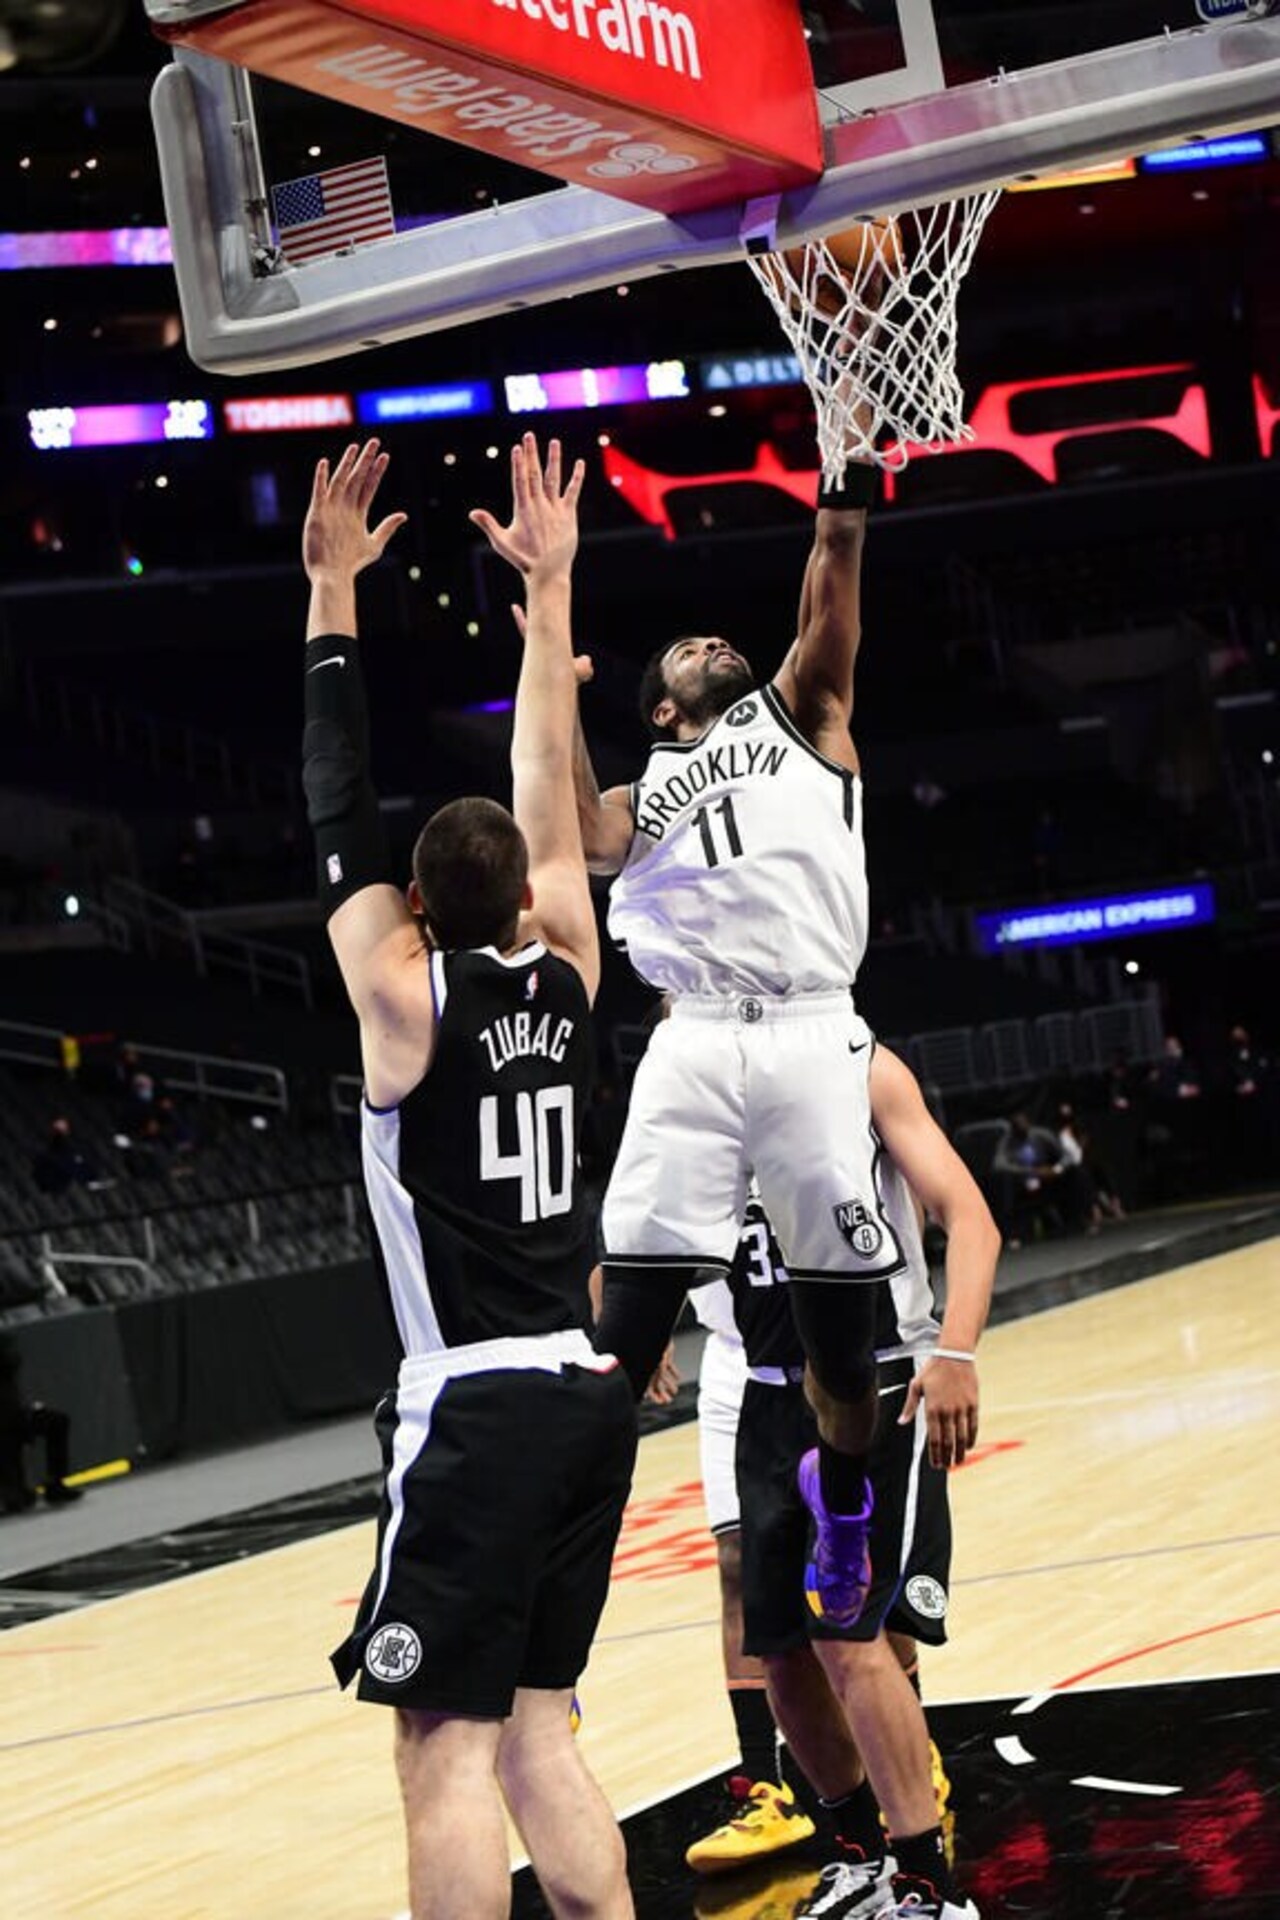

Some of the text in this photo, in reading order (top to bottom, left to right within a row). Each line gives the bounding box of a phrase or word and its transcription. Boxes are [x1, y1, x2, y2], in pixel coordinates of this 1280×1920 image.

[224, 396, 352, 431] TOSHIBA
[636, 742, 788, 841] BROOKLYN
[691, 794, 744, 869] 11
[1104, 894, 1196, 927] EXPRESS
[479, 1012, 574, 1072] ZUBAC
[479, 1084, 575, 1223] 40
